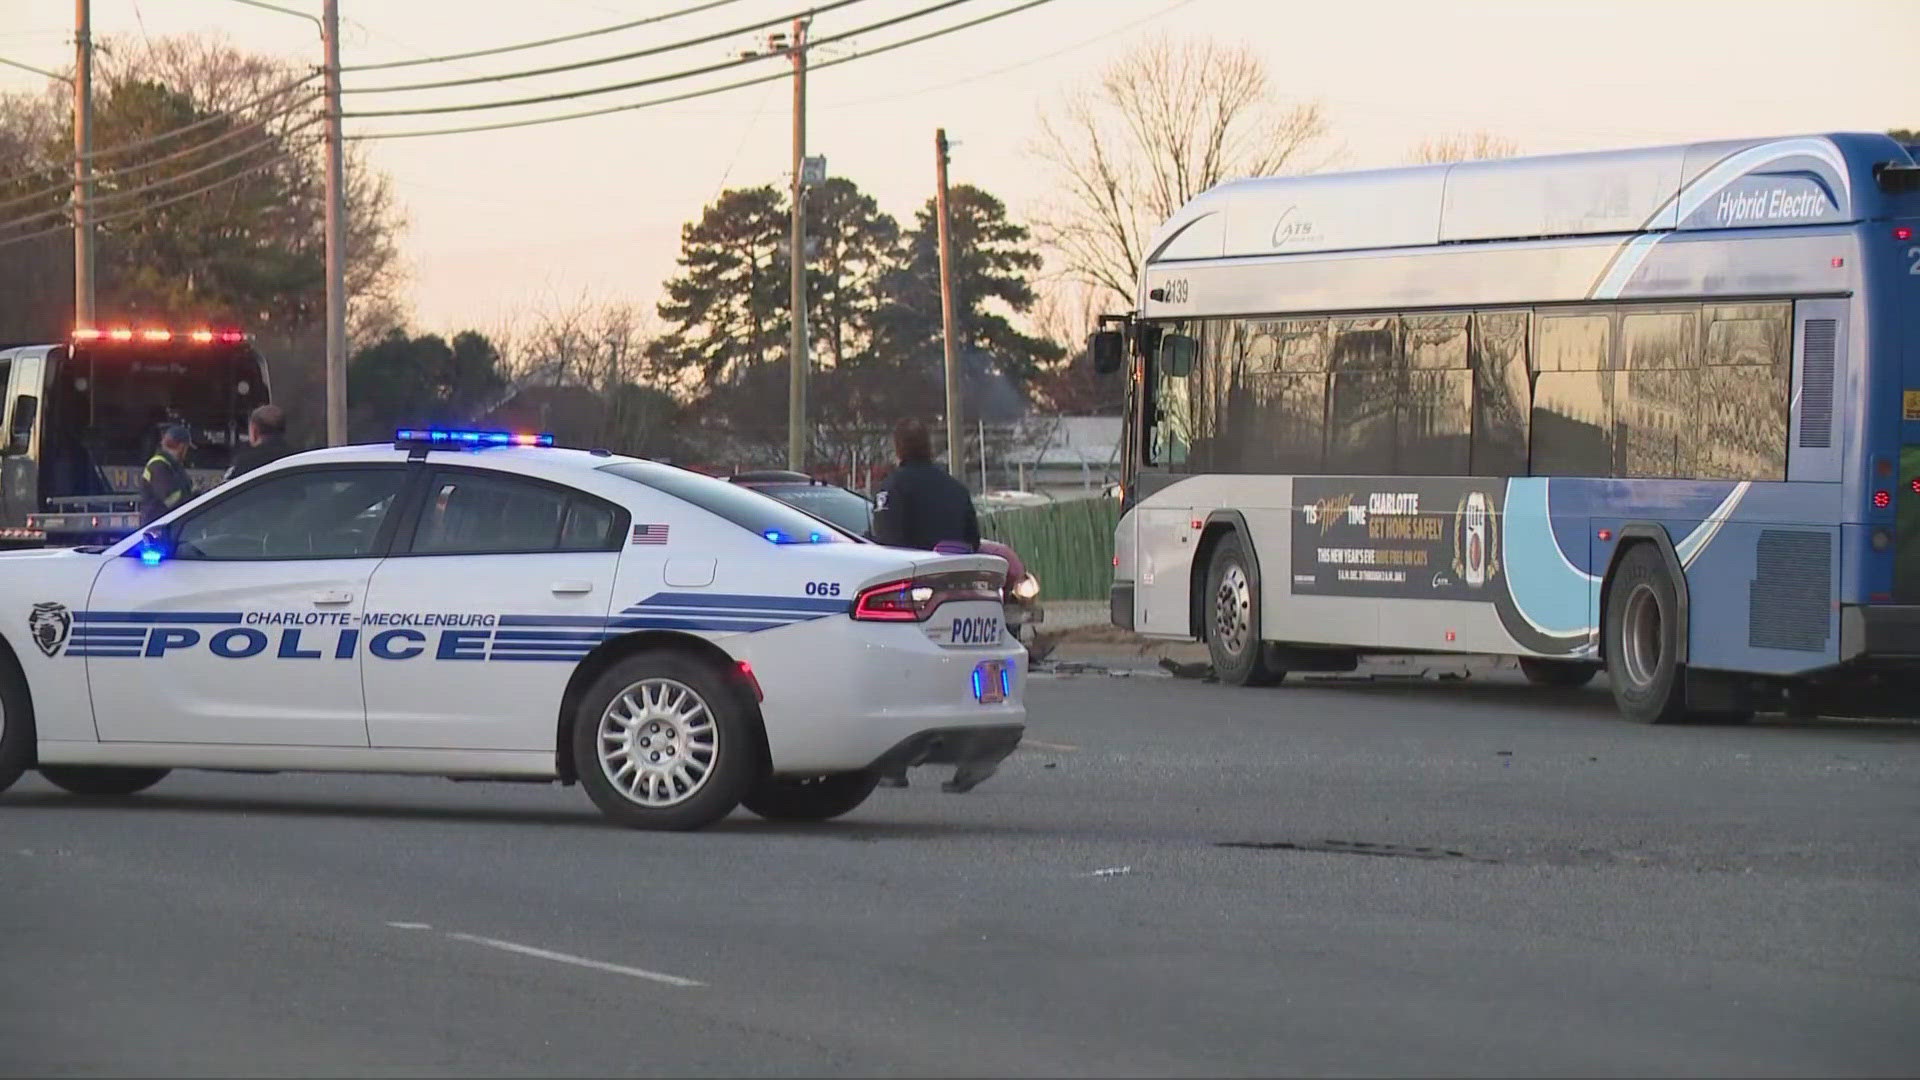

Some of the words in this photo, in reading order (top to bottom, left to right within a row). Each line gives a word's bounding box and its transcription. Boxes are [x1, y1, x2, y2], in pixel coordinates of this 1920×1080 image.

[1716, 190, 1768, 228] Hybrid
[1768, 187, 1826, 219] Electric
[1165, 279, 1188, 304] 2139
[1347, 504, 1367, 525] TIME
[1368, 492, 1419, 516] CHARLOTTE
[1368, 516, 1386, 538] GET
[1386, 517, 1413, 539] HOME
[1413, 518, 1444, 540] SAFELY
[1317, 547, 1330, 563] THIS
[1330, 548, 1344, 563] NEW
[805, 582, 840, 596] 065
[246, 612, 496, 627] CHARLOTTE-MECKLENBURG
[951, 617, 998, 643] POLICE
[144, 627, 492, 660] POLICE
